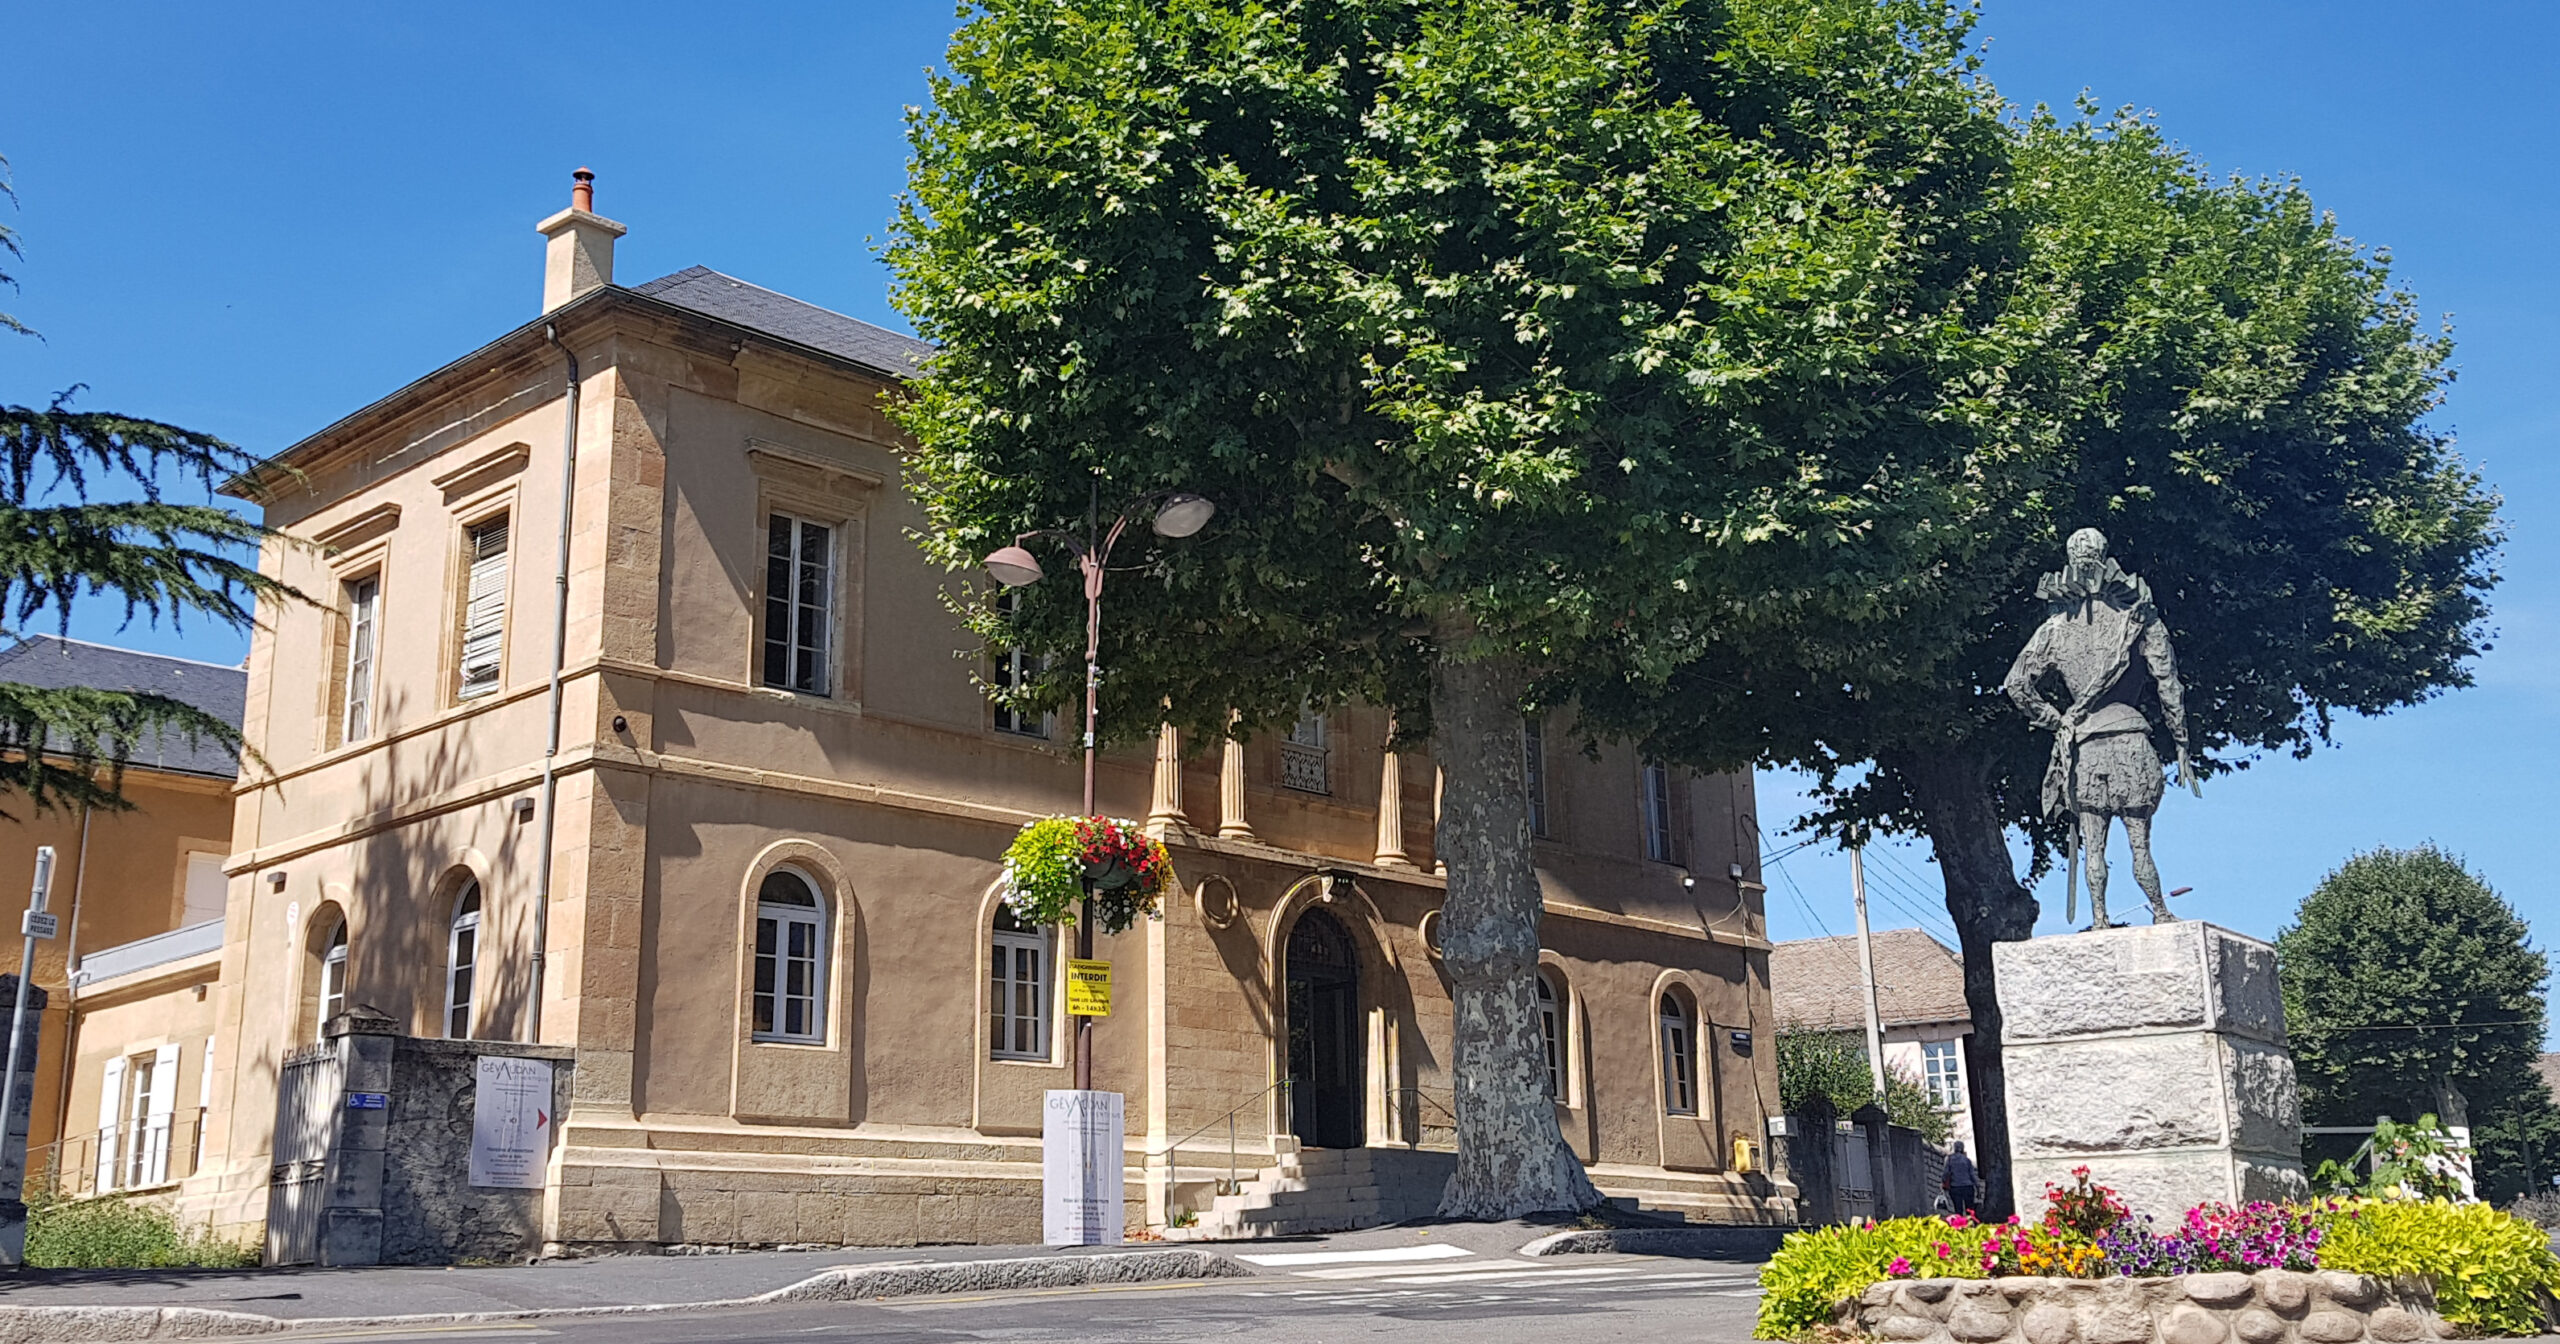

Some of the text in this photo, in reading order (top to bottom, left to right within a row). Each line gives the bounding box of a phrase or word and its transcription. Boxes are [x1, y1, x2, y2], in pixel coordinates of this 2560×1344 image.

[30, 925, 53, 935] PASSAGE
[1071, 973, 1107, 982] INTERDIT
[482, 1061, 536, 1080] GÉVAUDAN
